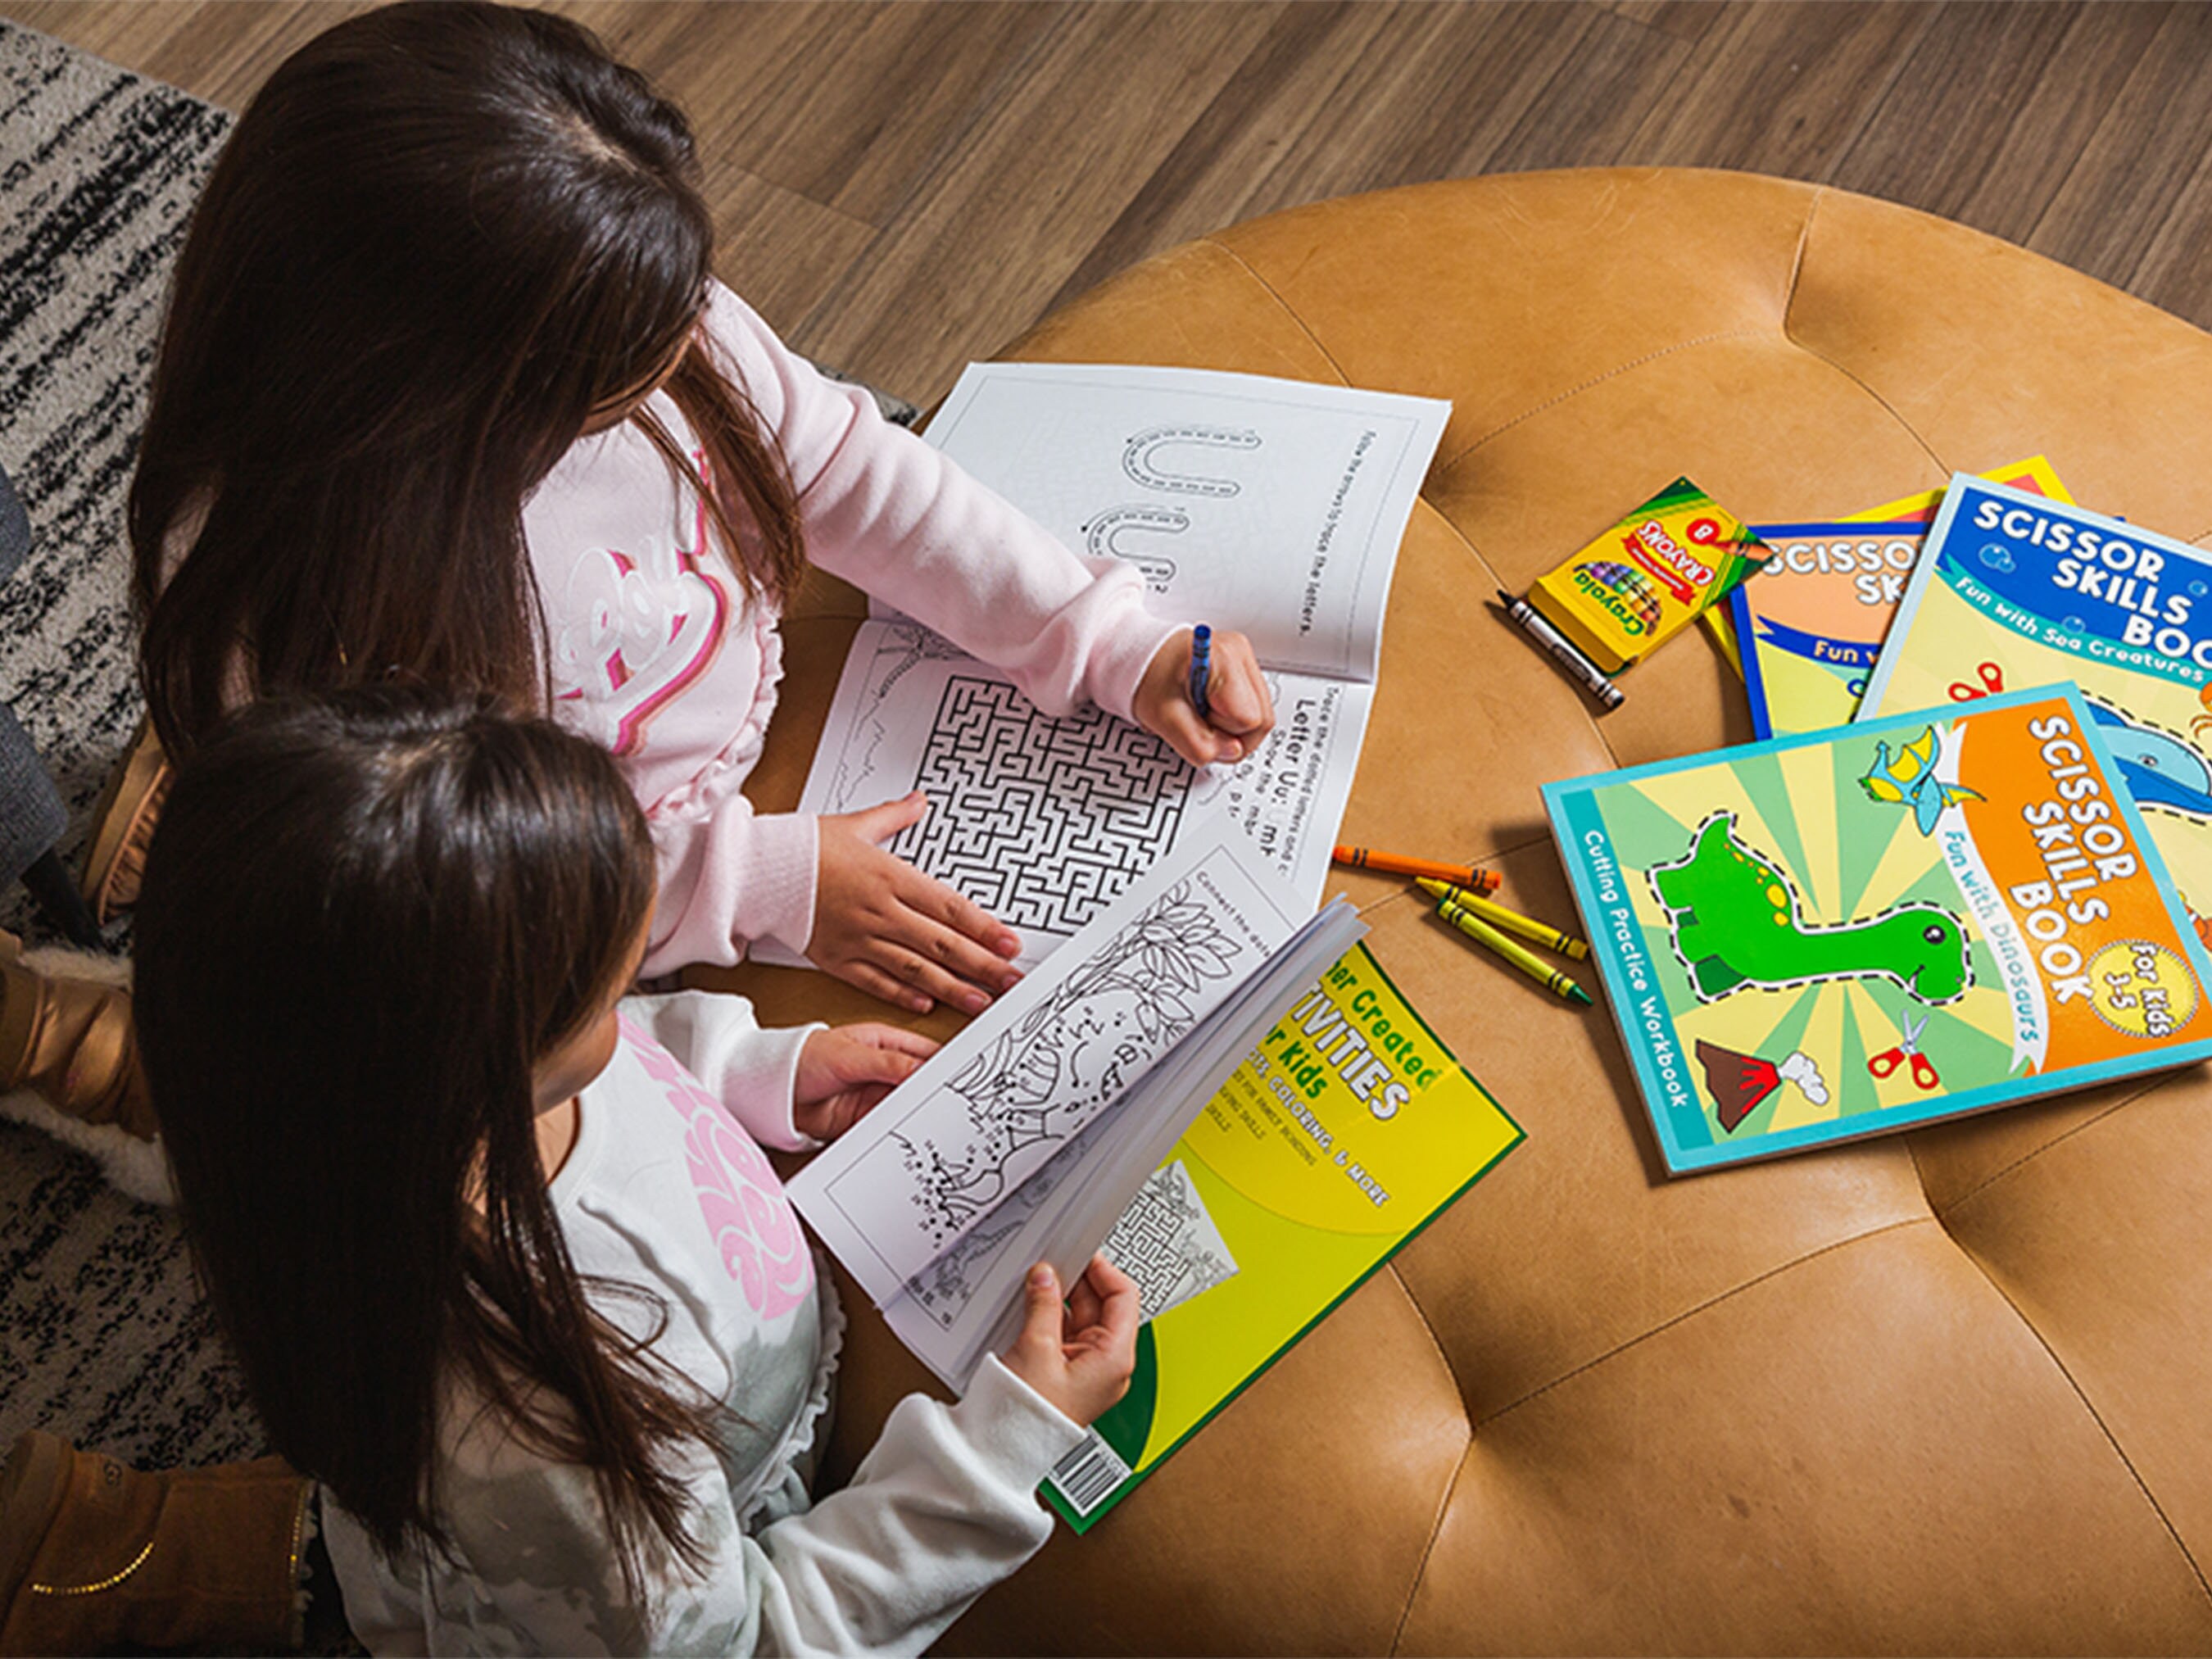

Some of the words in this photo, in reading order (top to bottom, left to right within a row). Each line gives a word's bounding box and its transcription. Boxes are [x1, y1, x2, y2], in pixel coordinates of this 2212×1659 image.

[1637, 520, 1715, 586] CRAYONS
[1693, 524, 1714, 541] 8
[1762, 541, 1922, 575] SCISSO
[1973, 499, 2165, 584] SCISSOR
[1311, 555, 1326, 578] the
[2051, 557, 2193, 626] SKILLS
[1299, 582, 1320, 637] letters.
[1574, 572, 1644, 636] Crayola
[1956, 576, 1992, 606] Fun
[1995, 602, 2038, 636] with
[2042, 628, 2083, 651] Sea
[2088, 641, 2205, 683] Creatures
[1813, 640, 1859, 664] Fun
[1285, 699, 1317, 764] Letter
[1319, 687, 1339, 723] Trace
[1313, 726, 1328, 749] the
[1271, 770, 1299, 805] Uu:
[2028, 715, 2138, 882] SCISSOR
[2021, 800, 2111, 926] SKILLS
[1196, 871, 1235, 914] Connect
[1234, 913, 1249, 933] the
[1249, 934, 1270, 957] dots
[1944, 829, 1966, 868] Fun
[1960, 870, 2000, 920] with
[1988, 922, 2040, 1043] Dinosaurs
[2009, 879, 2095, 1005] BOOK
[1584, 829, 1619, 904] Cutting
[1609, 907, 1648, 992] Practice
[1639, 995, 1689, 1108] Workbook
[2104, 971, 2138, 1010] 3-5
[2129, 944, 2159, 984] For
[2139, 987, 2176, 1037] Kids
[1278, 1040, 1329, 1099] Kids
[1267, 1075, 1335, 1155] COLORING,
[1344, 1162, 1391, 1208] MORE
